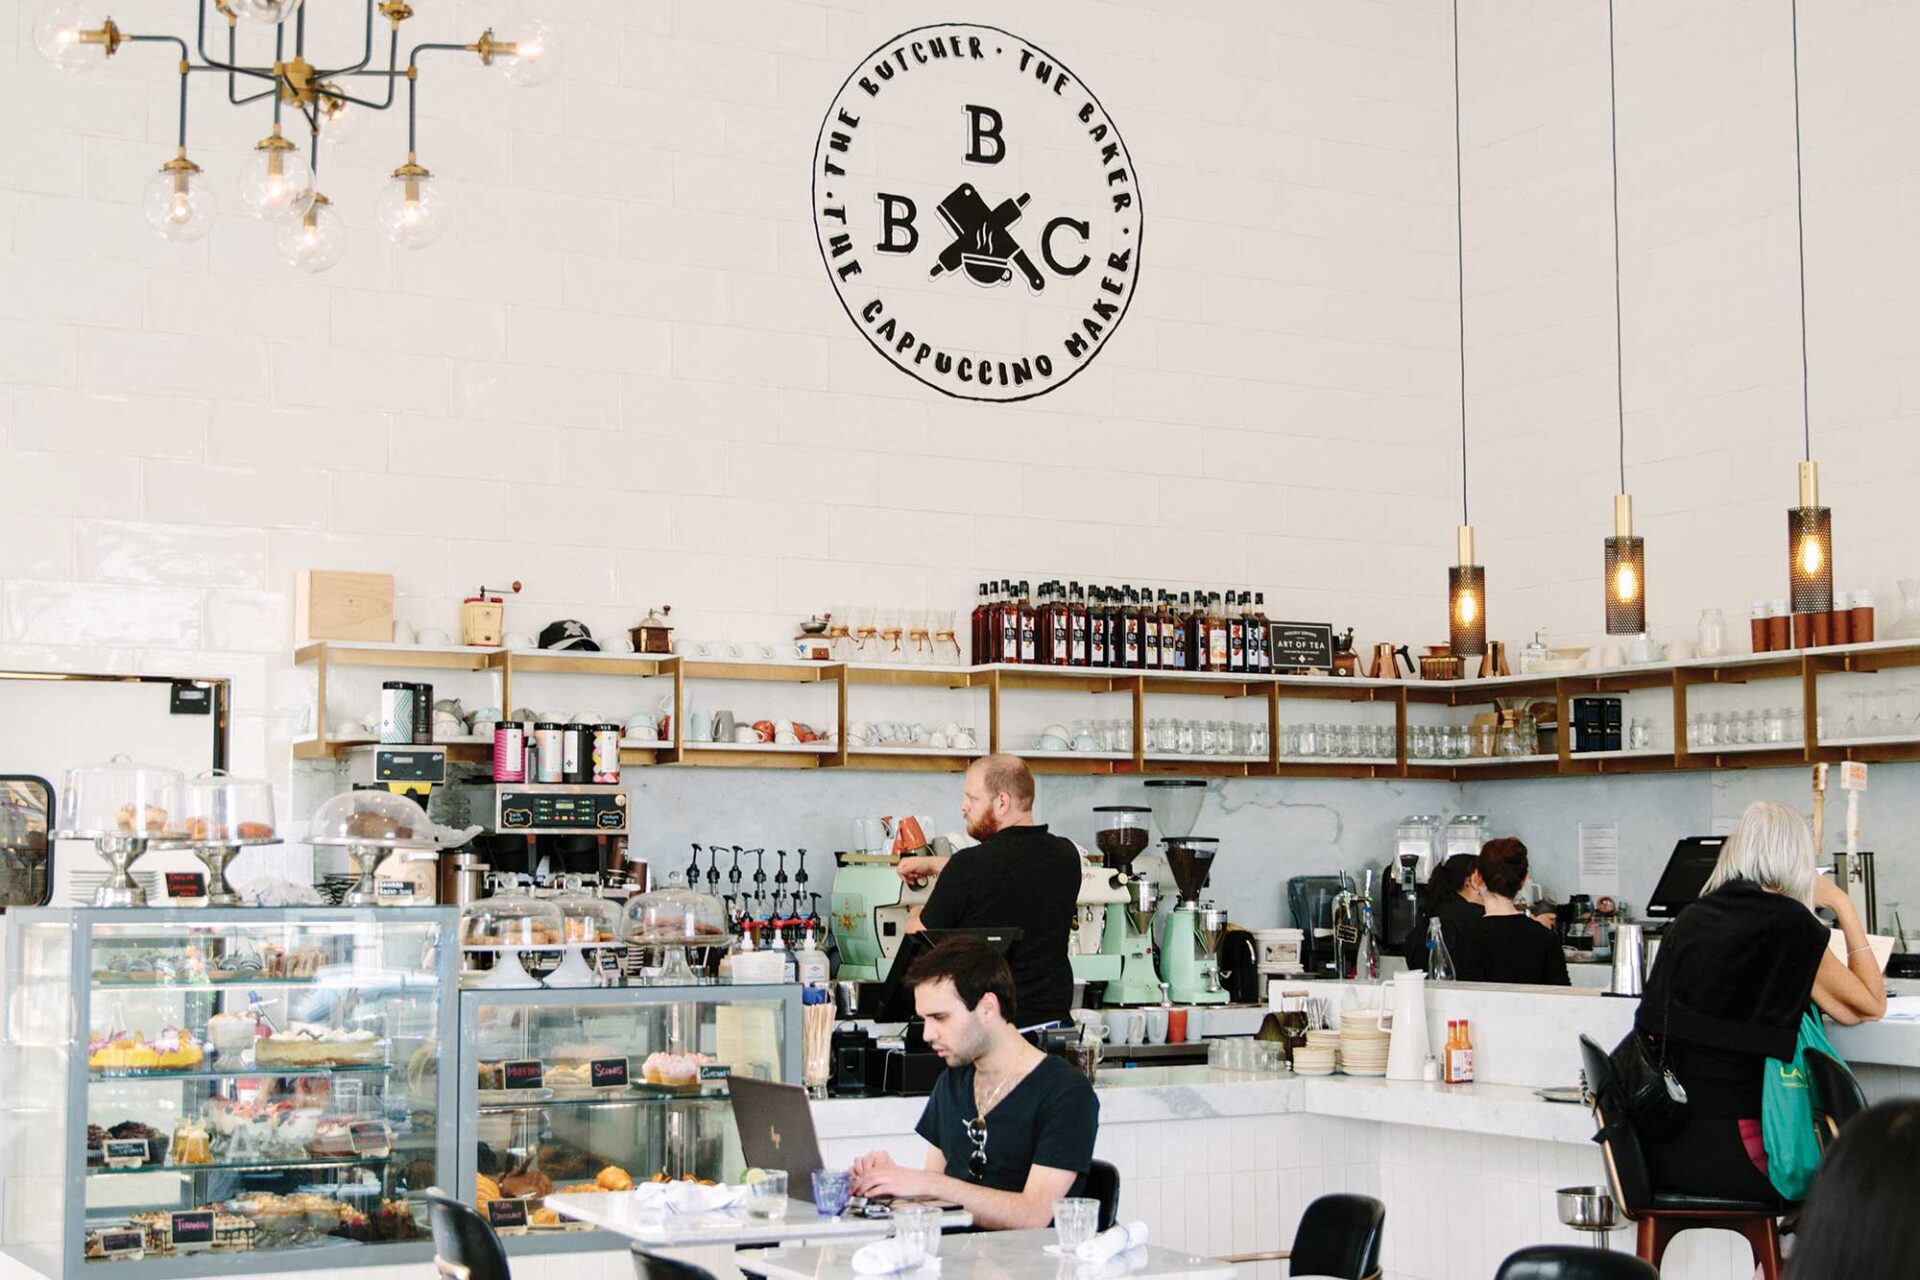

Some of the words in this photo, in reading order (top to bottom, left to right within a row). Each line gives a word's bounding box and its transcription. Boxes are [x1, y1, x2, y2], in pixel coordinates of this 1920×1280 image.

[824, 107, 861, 175] THE
[859, 36, 984, 97] BUTCHER
[964, 104, 1006, 165] B
[1019, 48, 1070, 96] THE
[1079, 103, 1132, 212] BAKER
[876, 192, 919, 254] B
[1042, 216, 1091, 277] C
[824, 206, 862, 283] THE
[862, 299, 1053, 386] CAPPUCCINO
[1064, 248, 1131, 358] MAKER
[1277, 640, 1293, 648] ART
[1295, 640, 1307, 649] OF
[1309, 641, 1326, 650] TEA
